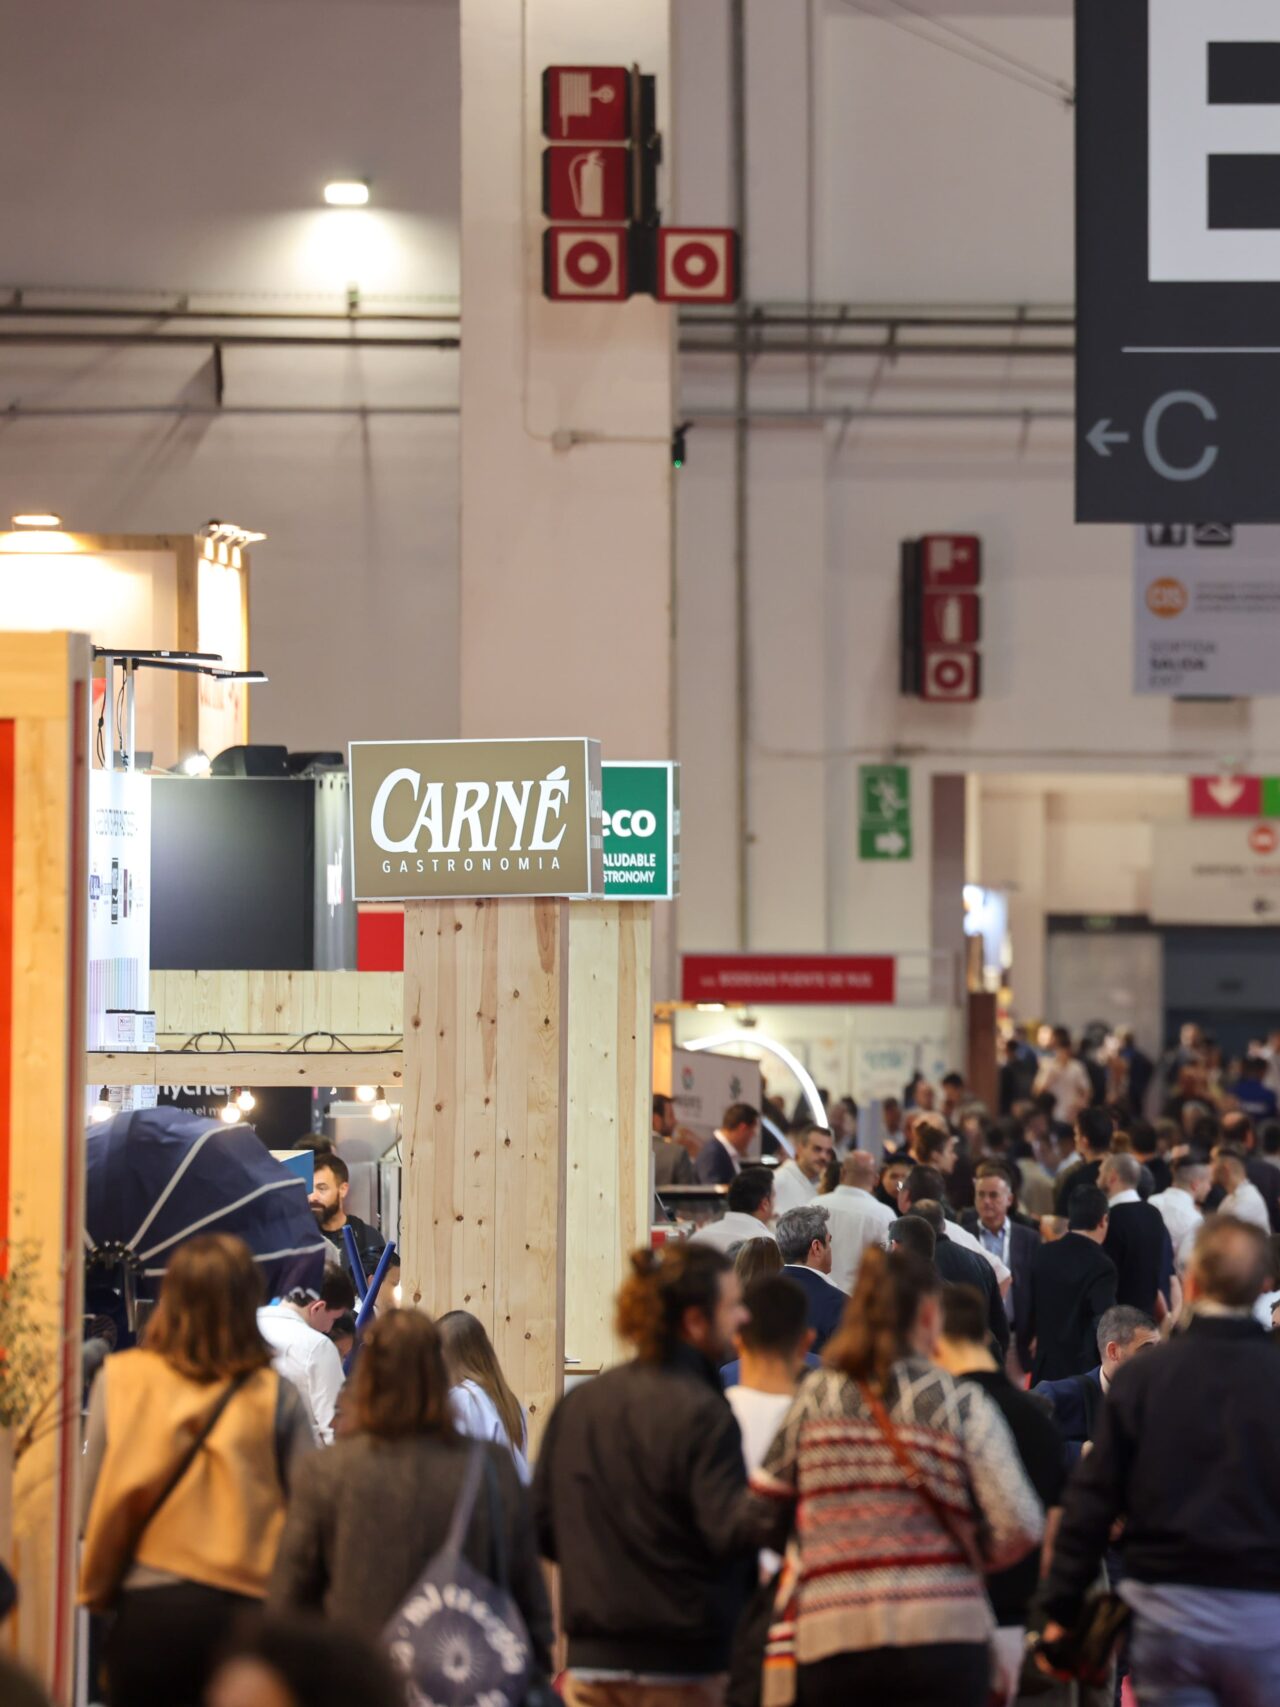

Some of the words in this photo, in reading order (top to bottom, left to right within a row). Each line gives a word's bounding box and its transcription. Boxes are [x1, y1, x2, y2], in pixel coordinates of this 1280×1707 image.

[1142, 390, 1219, 481] C
[370, 765, 570, 853] CARNÉ
[382, 856, 561, 873] GASTRONOMIA
